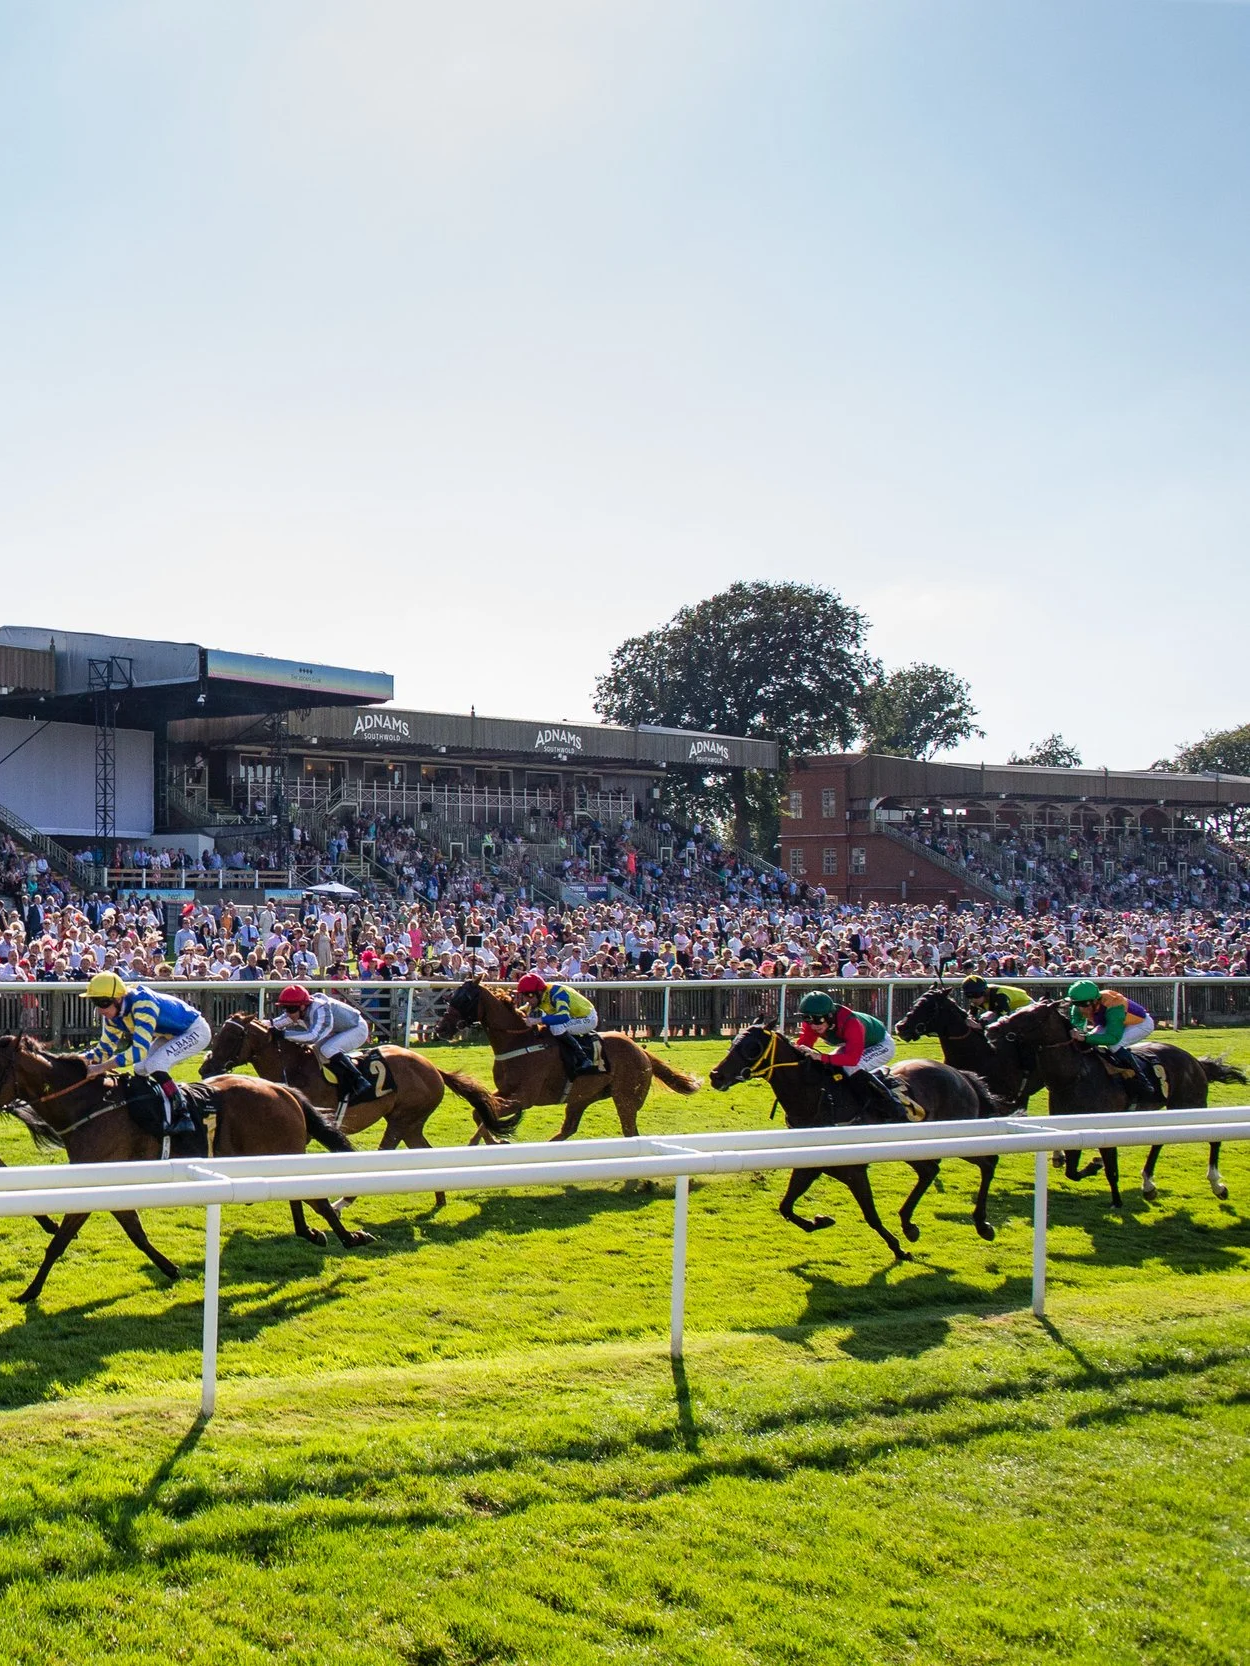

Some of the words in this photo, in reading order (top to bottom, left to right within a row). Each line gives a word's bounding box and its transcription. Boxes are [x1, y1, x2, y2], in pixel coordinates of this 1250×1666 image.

[353, 714, 409, 736] ADNAMS
[363, 732, 401, 742] SOUTHWOLD
[534, 728, 581, 750] ADNAMS
[543, 745, 575, 754] SOUTHWOLD
[688, 740, 729, 760] ADNAMS
[165, 1031, 200, 1057] ALBASTI
[369, 1060, 394, 1098] 2
